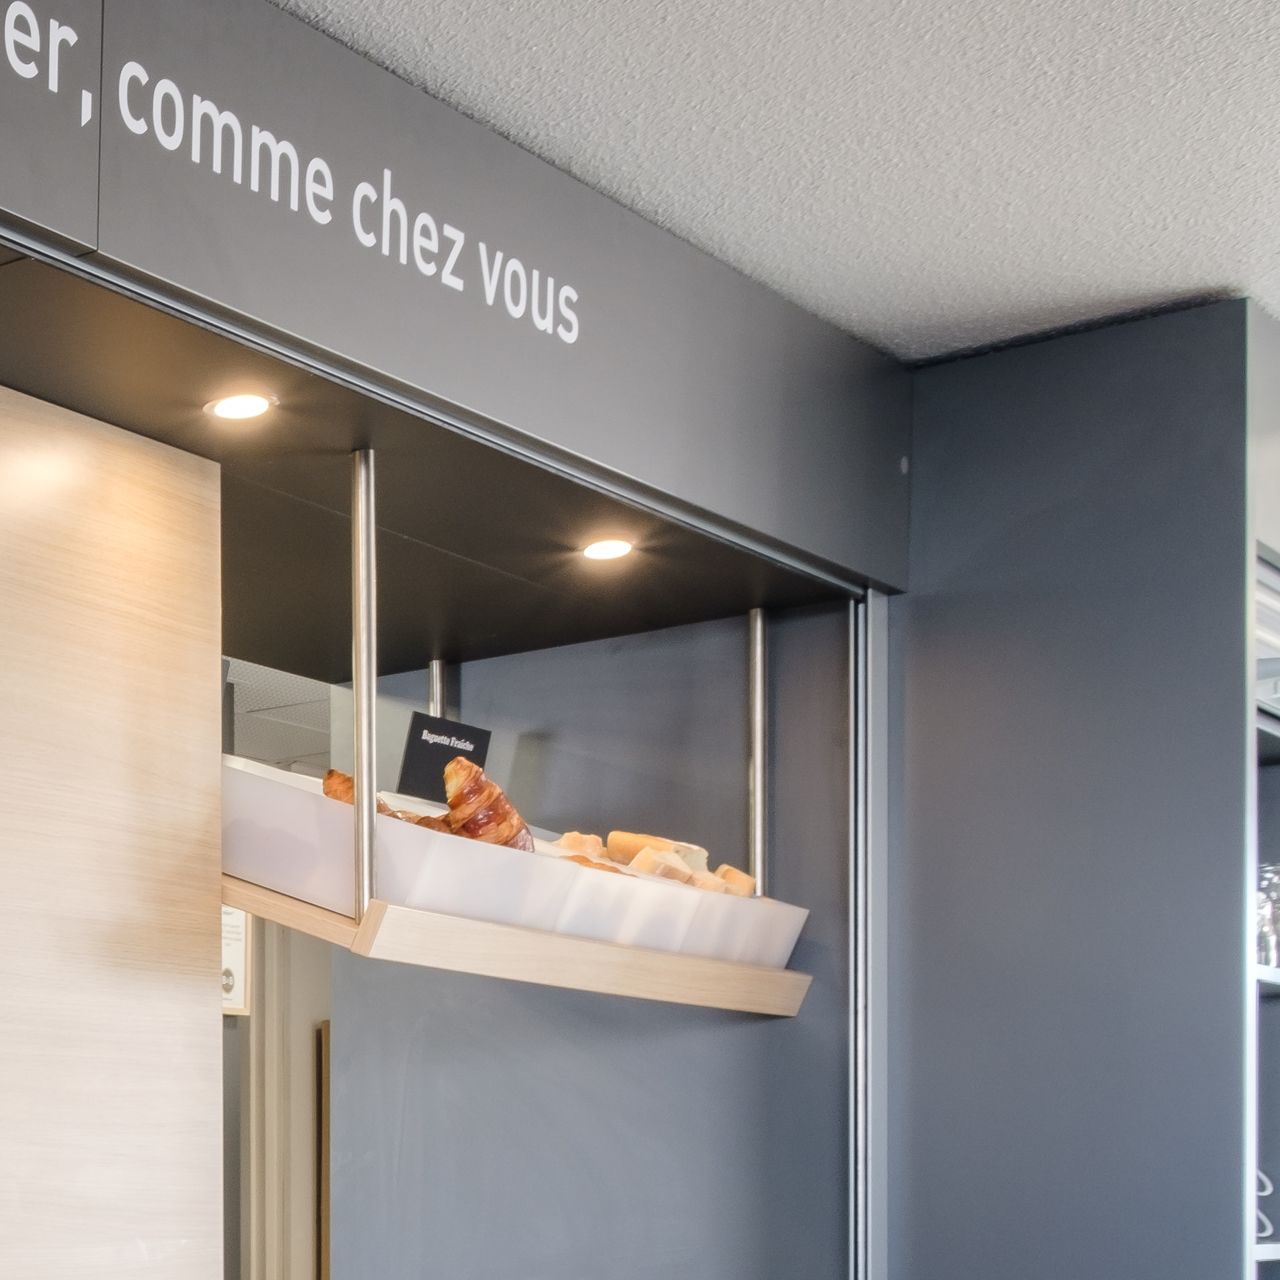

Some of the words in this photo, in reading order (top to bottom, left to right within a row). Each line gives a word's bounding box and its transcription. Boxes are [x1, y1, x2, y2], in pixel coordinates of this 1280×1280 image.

[119, 61, 334, 224] comme
[352, 168, 465, 291] chez
[478, 242, 579, 344] vous
